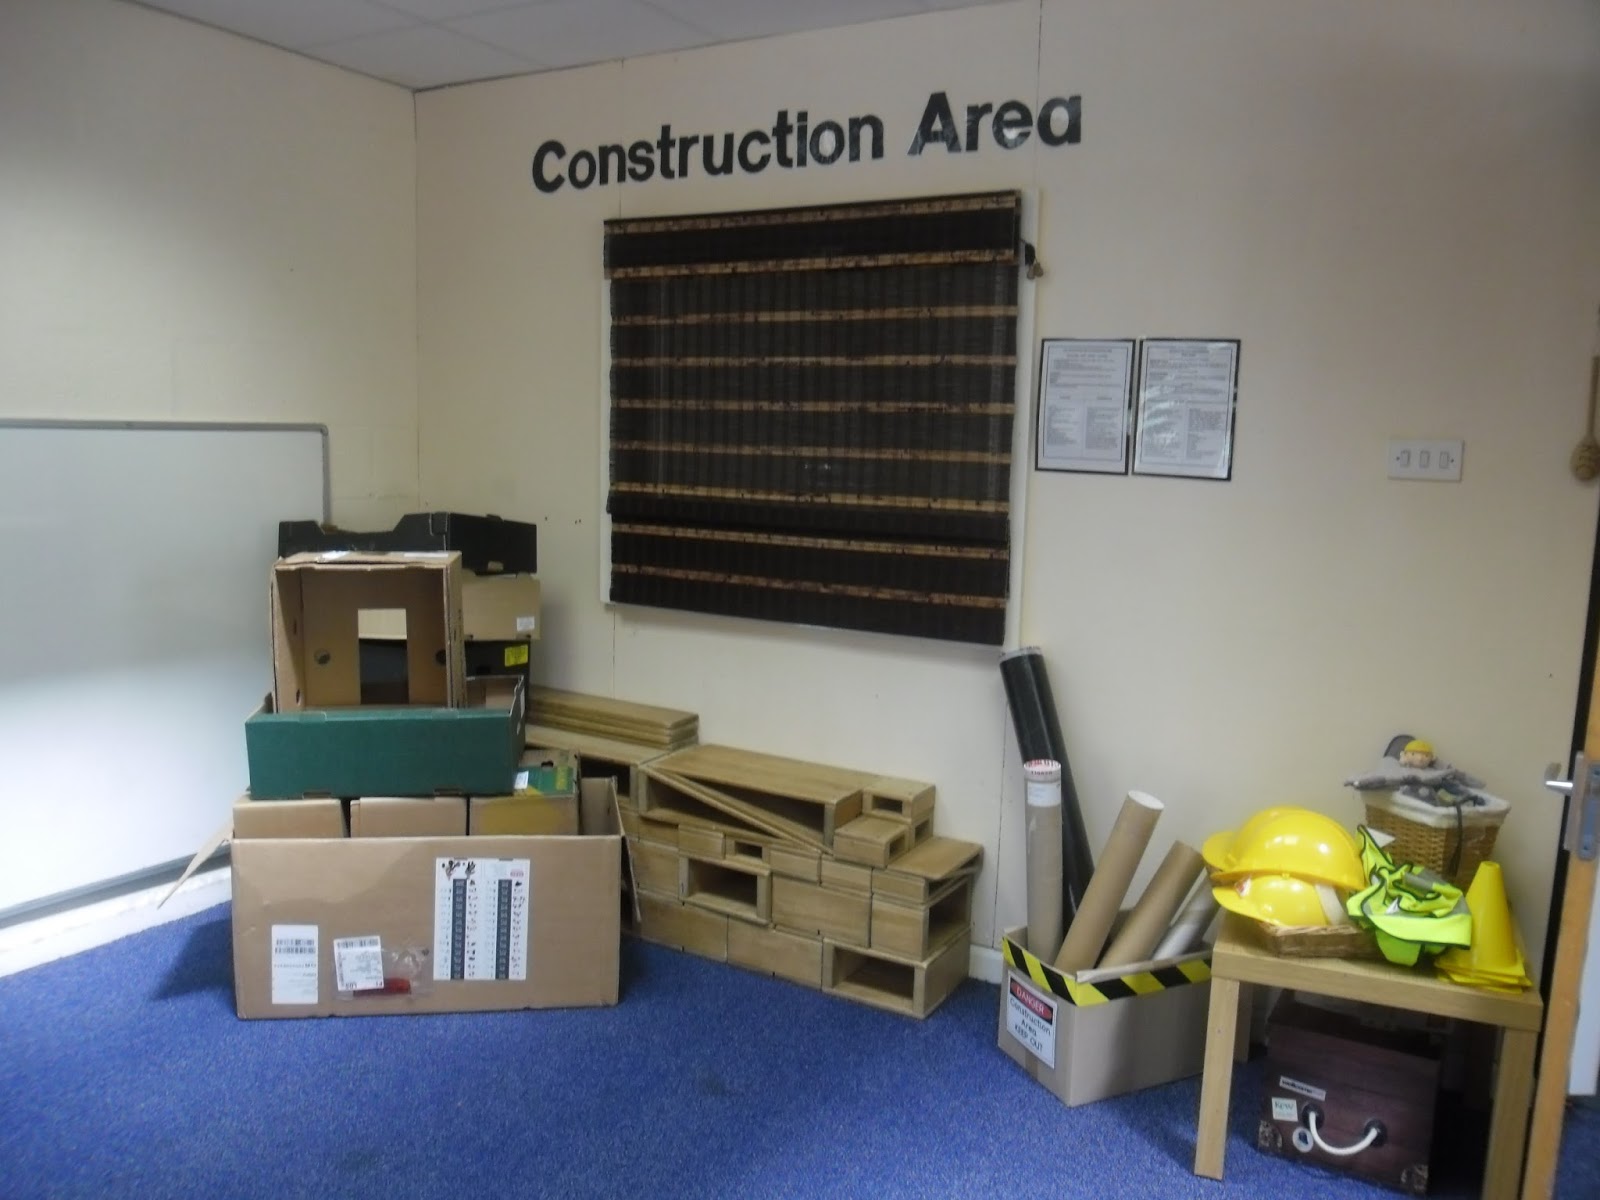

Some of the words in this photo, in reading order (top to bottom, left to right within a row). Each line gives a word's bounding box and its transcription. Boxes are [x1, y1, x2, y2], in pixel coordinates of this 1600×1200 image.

[532, 108, 884, 193] Construction
[907, 91, 1082, 155] Area
[1016, 986, 1044, 1015] DANGER
[1010, 998, 1051, 1036] Construction
[1021, 1019, 1037, 1037] Area
[1015, 1024, 1028, 1039] KEEP
[1030, 1037, 1043, 1053] OUT
